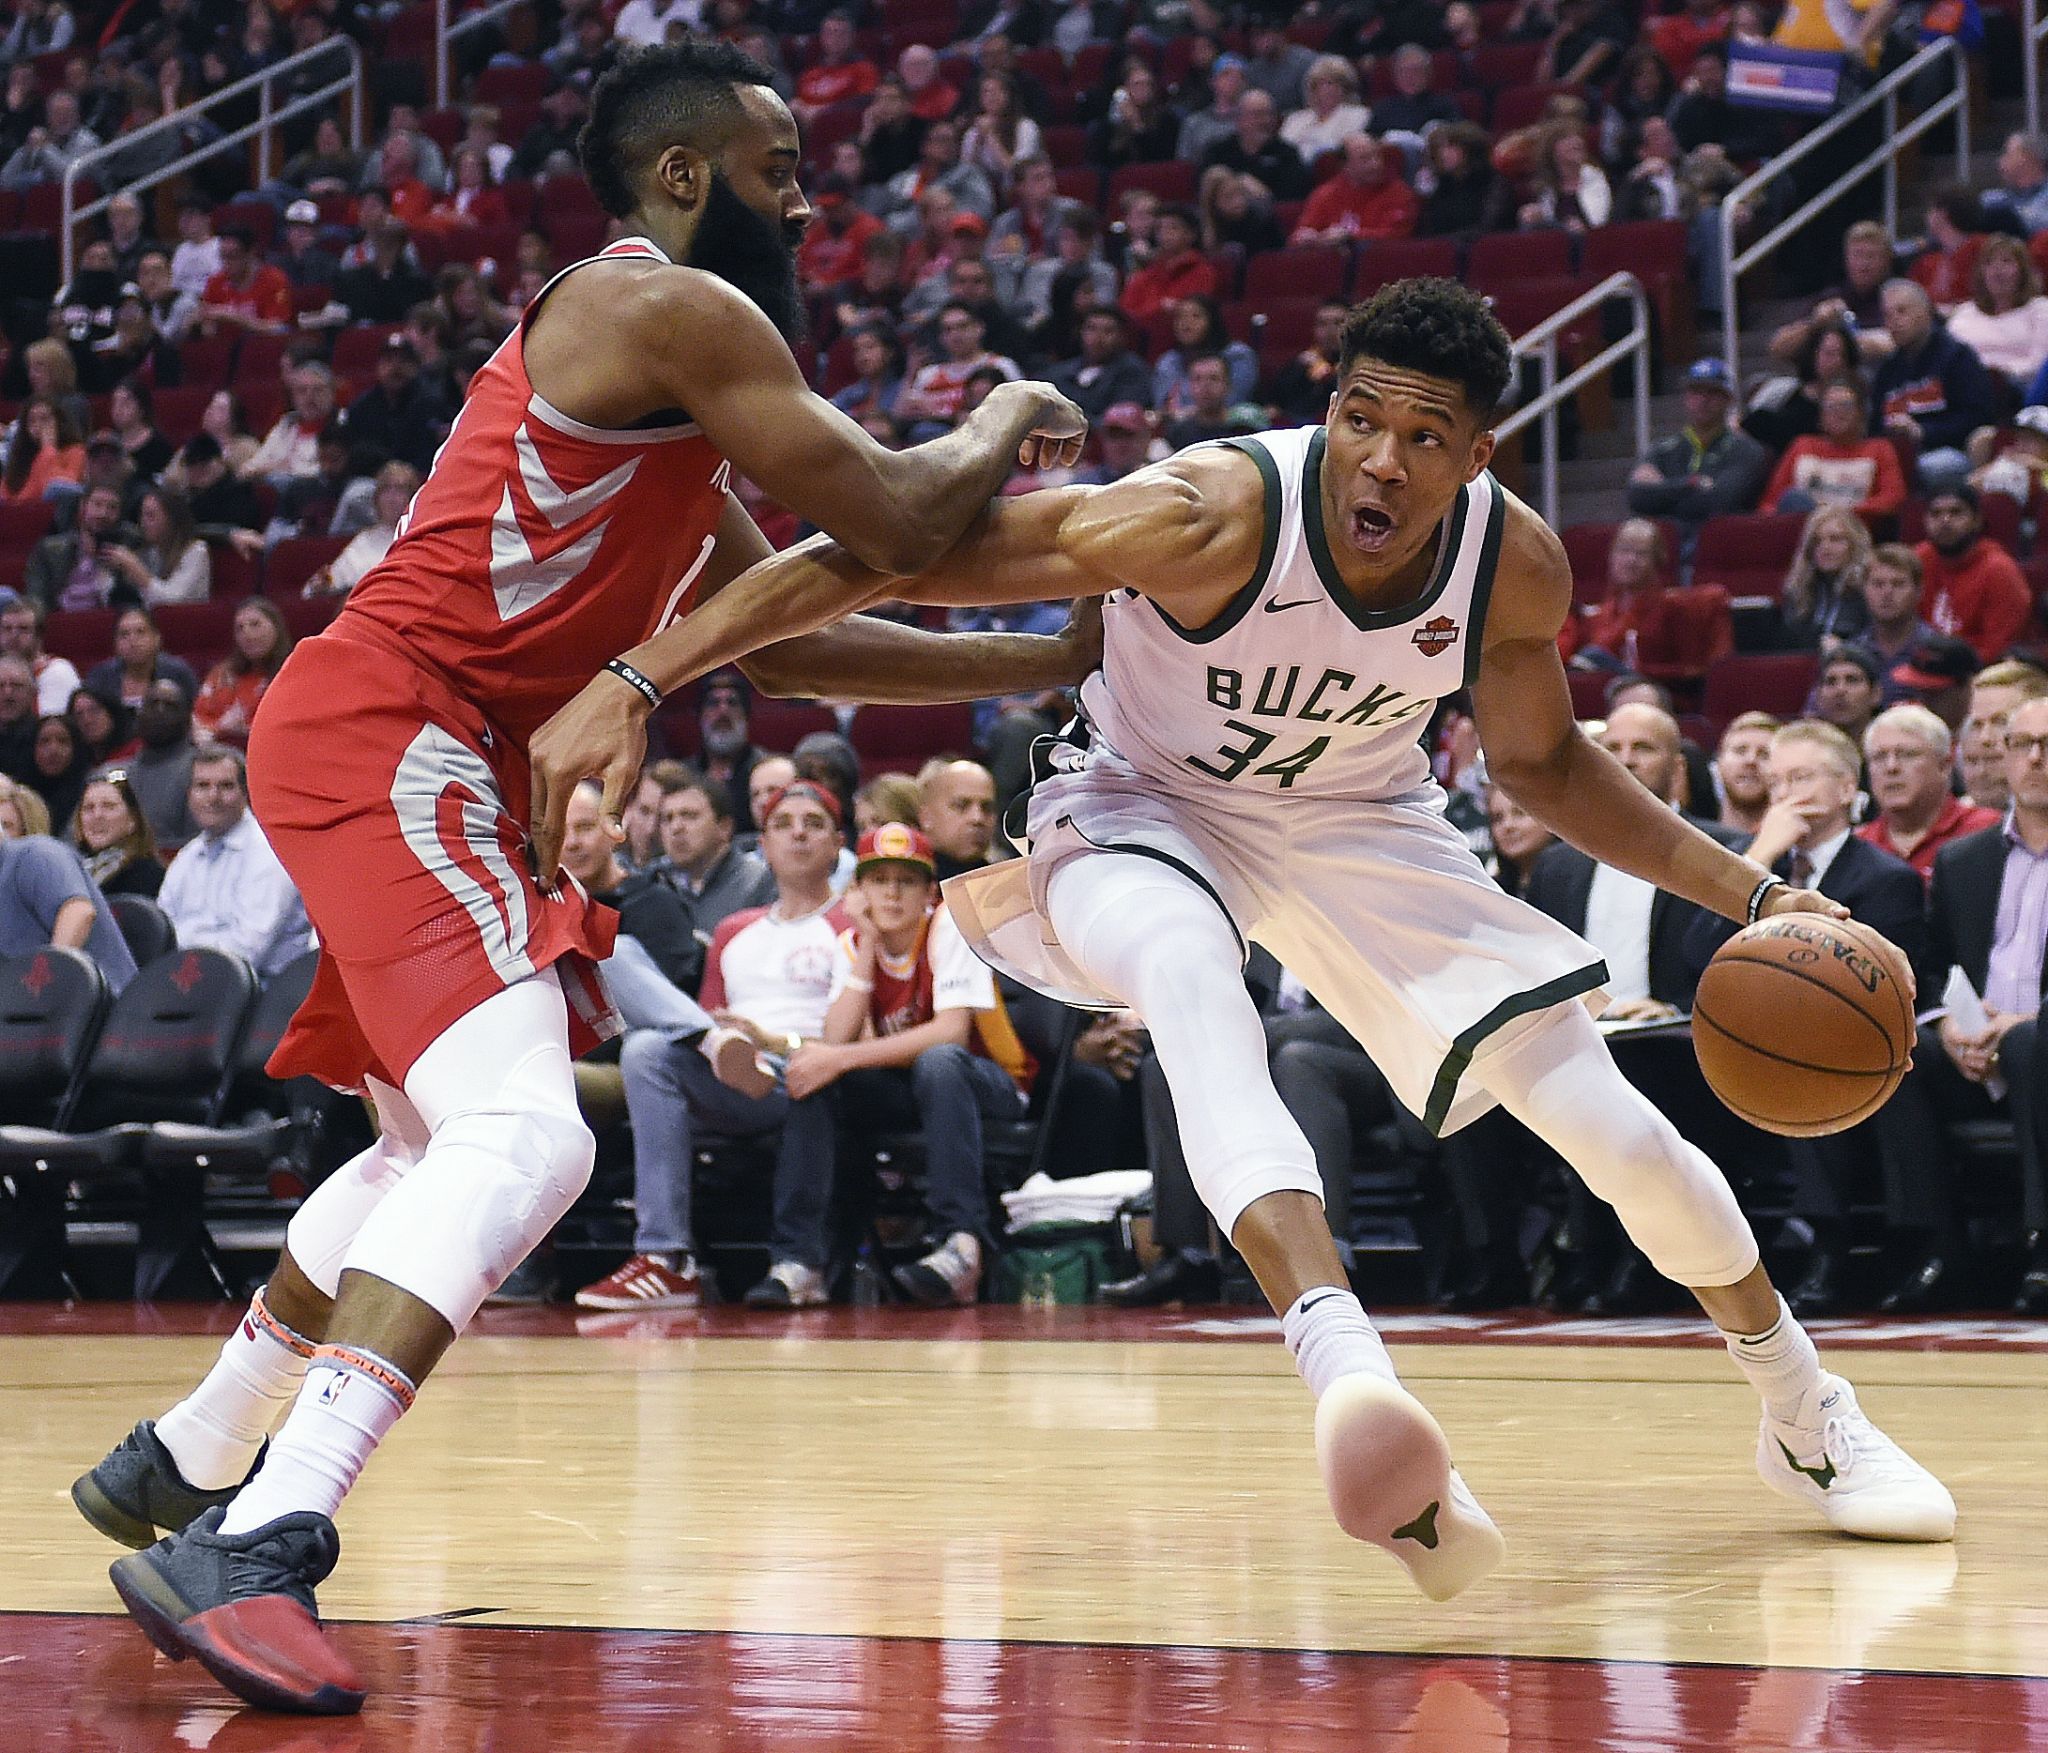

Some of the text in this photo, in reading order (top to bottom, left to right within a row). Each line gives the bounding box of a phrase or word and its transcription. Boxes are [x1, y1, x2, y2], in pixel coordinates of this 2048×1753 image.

[652, 534, 716, 638] 1
[1206, 664, 1432, 726] BUCKS
[1185, 719, 1332, 788] 34
